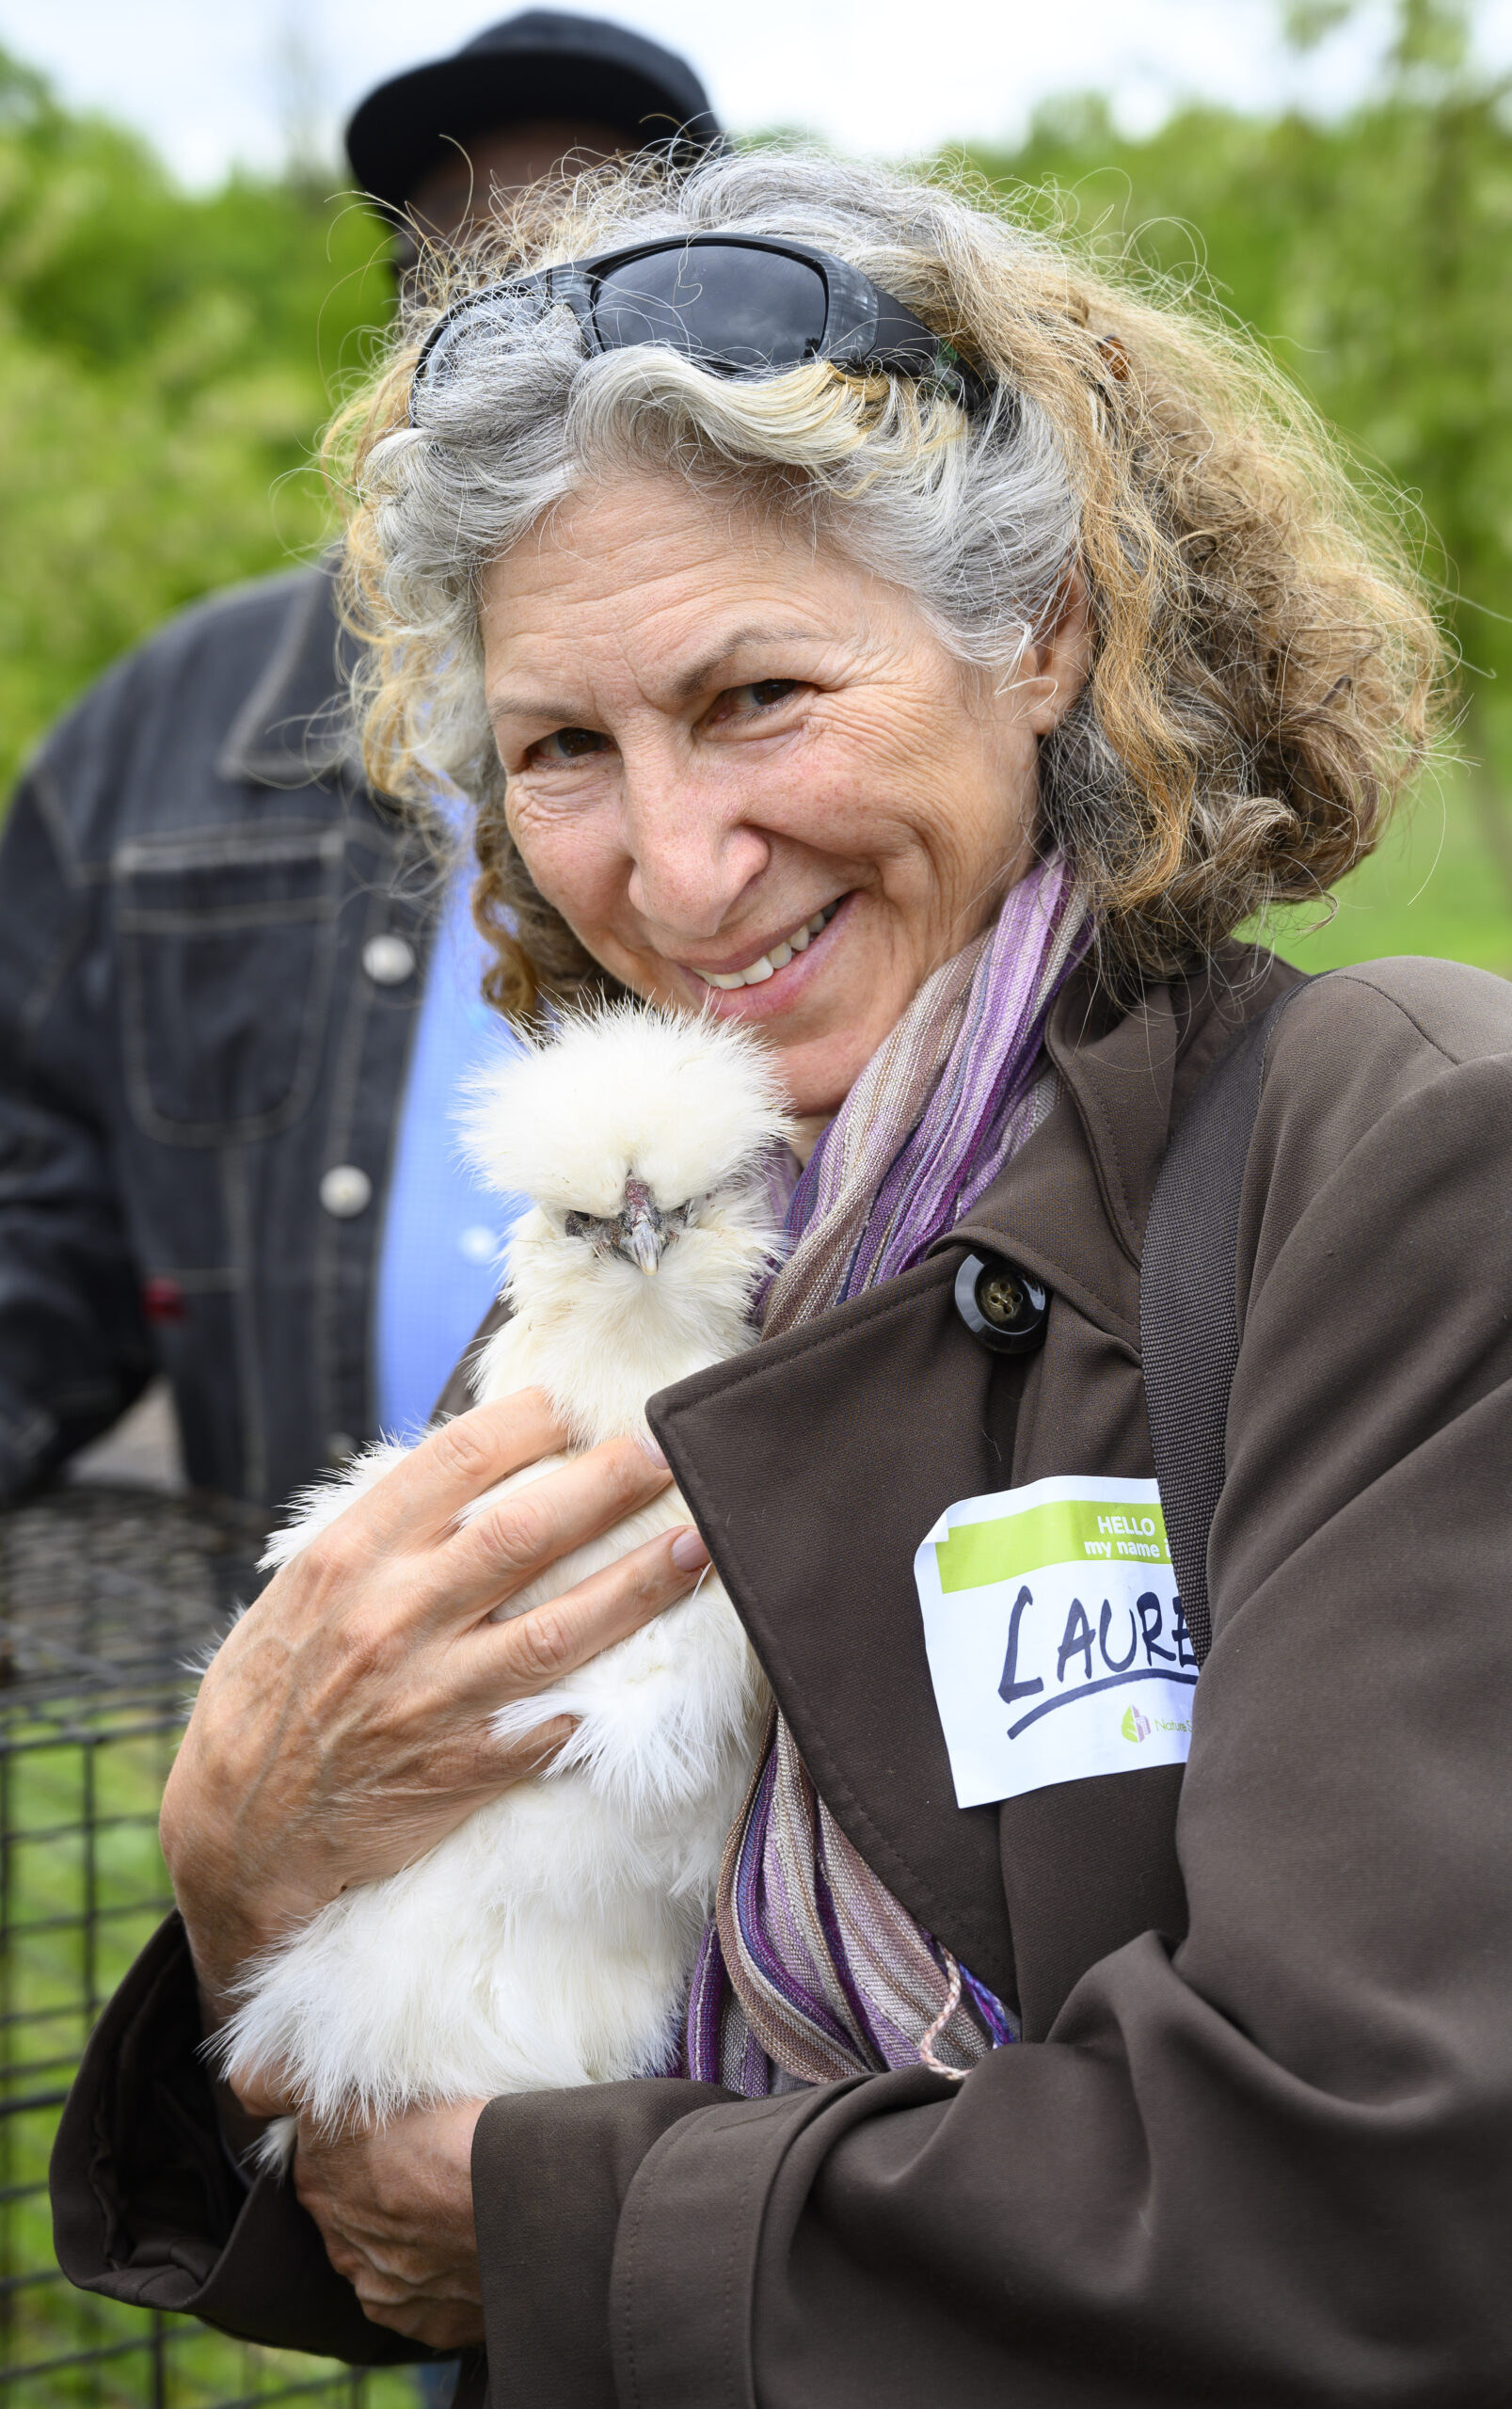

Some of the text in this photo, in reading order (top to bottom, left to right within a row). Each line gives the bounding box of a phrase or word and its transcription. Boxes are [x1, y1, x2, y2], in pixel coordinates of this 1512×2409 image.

[1097, 1515, 1155, 1536] HELLO
[1084, 1541, 1111, 1558] my
[1116, 1541, 1160, 1557] name
